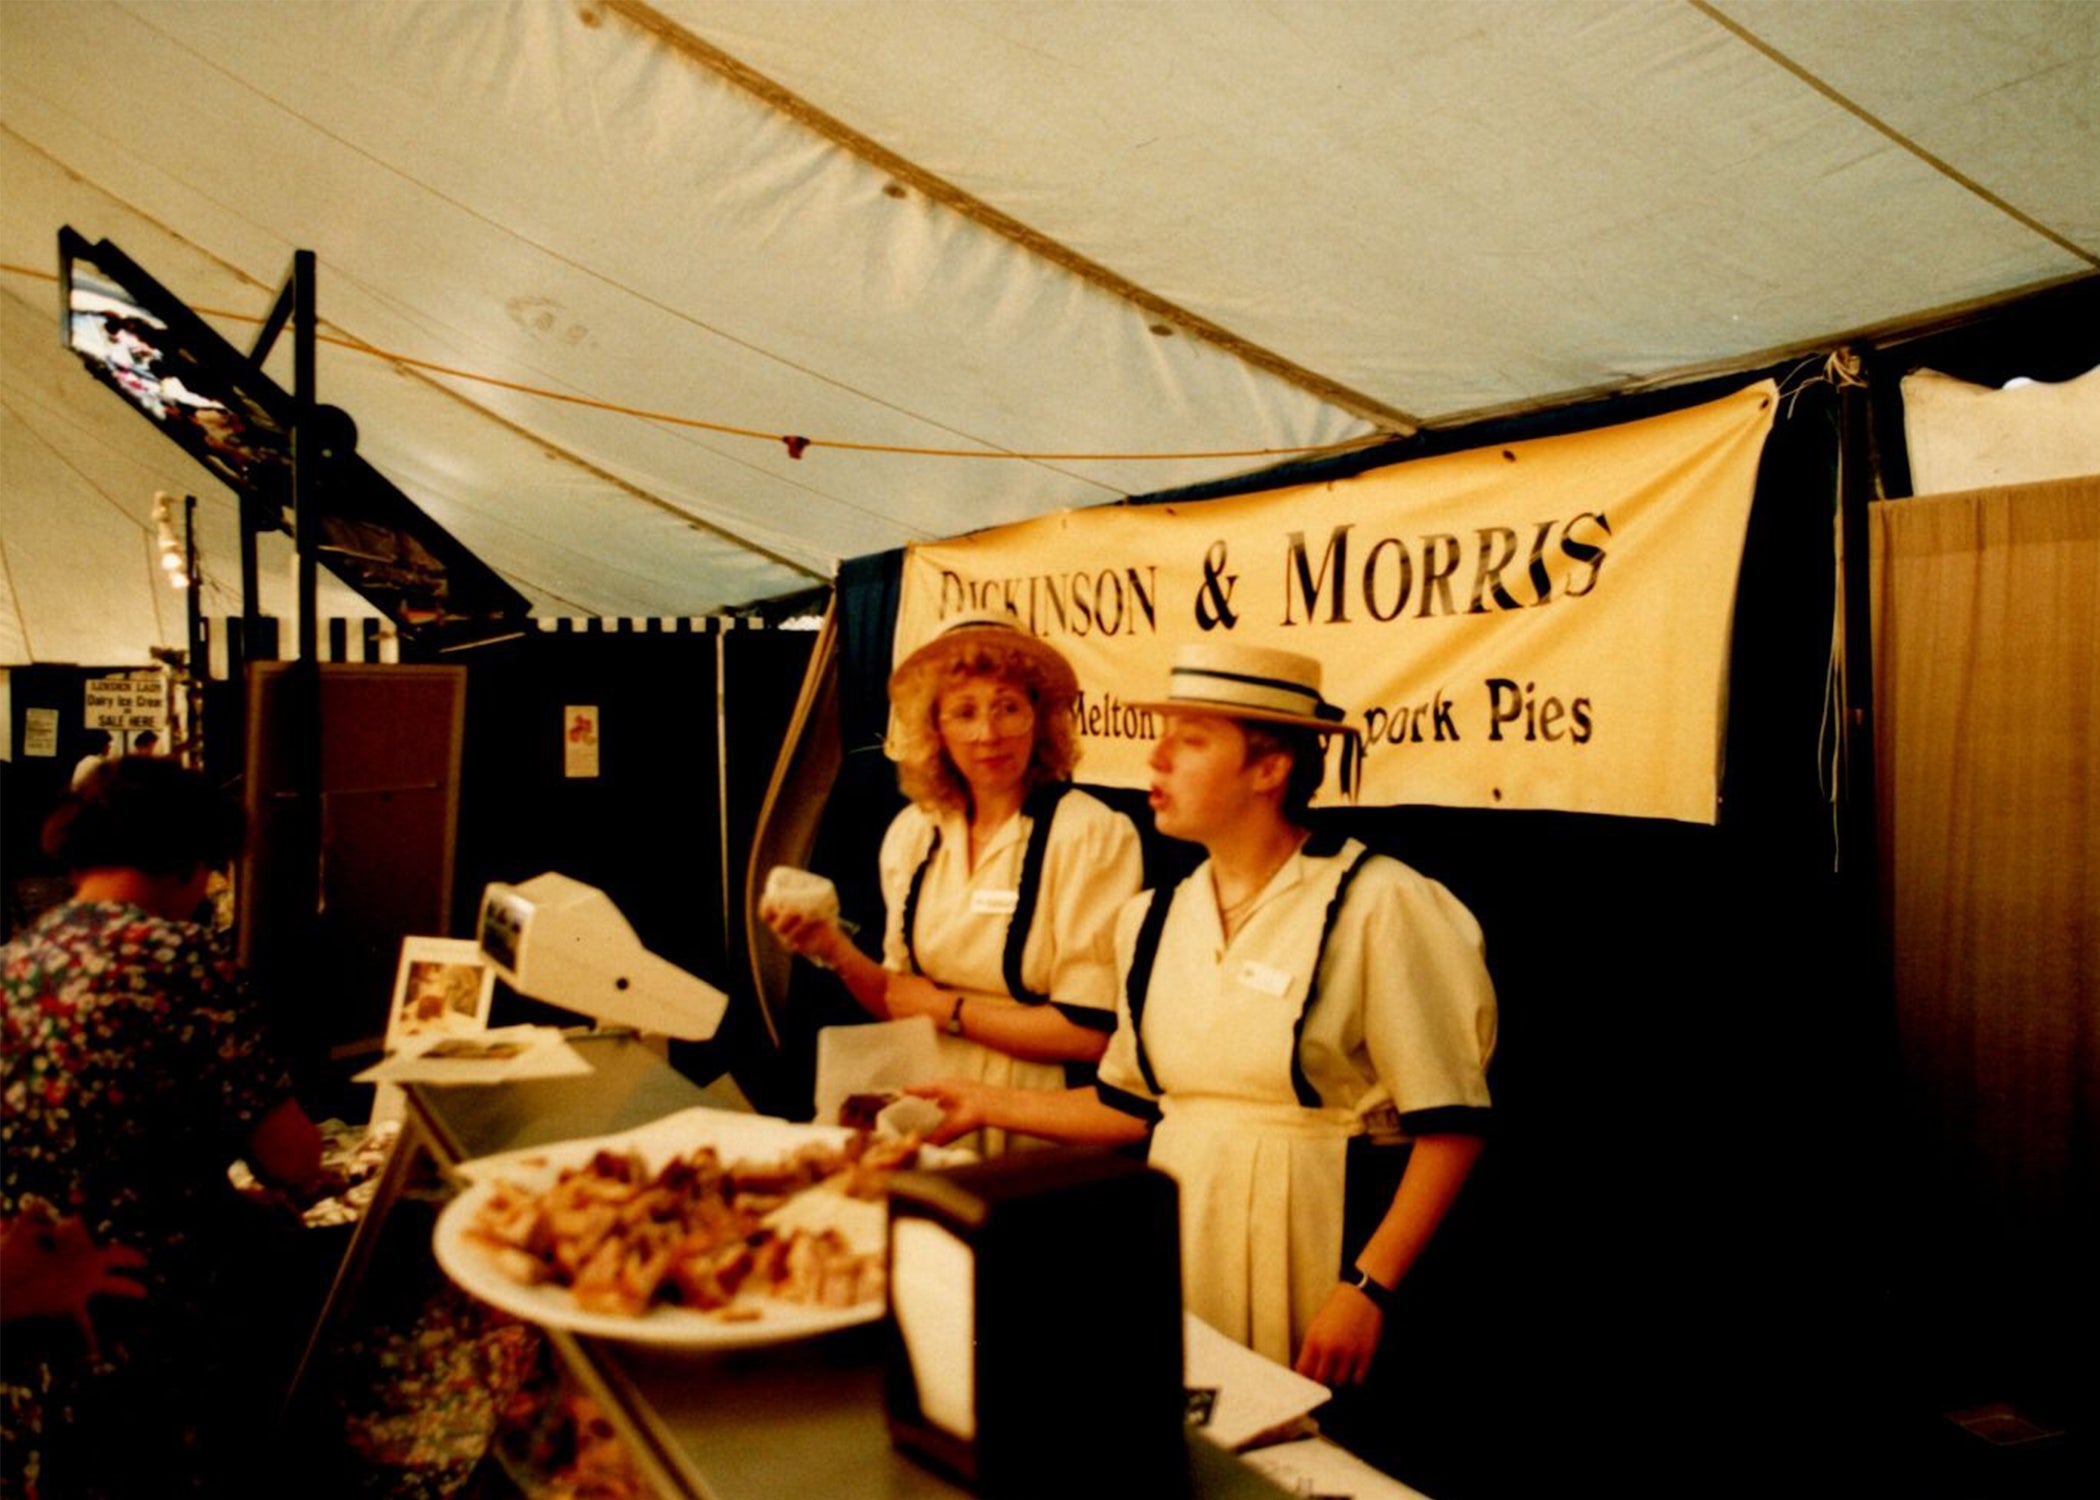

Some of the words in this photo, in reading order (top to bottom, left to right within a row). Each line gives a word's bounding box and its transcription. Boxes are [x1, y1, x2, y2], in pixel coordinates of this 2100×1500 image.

[939, 565, 1158, 638] DICKINSON
[1194, 539, 1240, 632] &
[1280, 511, 1613, 627] MORRIS
[99, 715, 124, 727] SALE
[1362, 689, 1461, 759] pork
[1484, 677, 1594, 745] Pies
